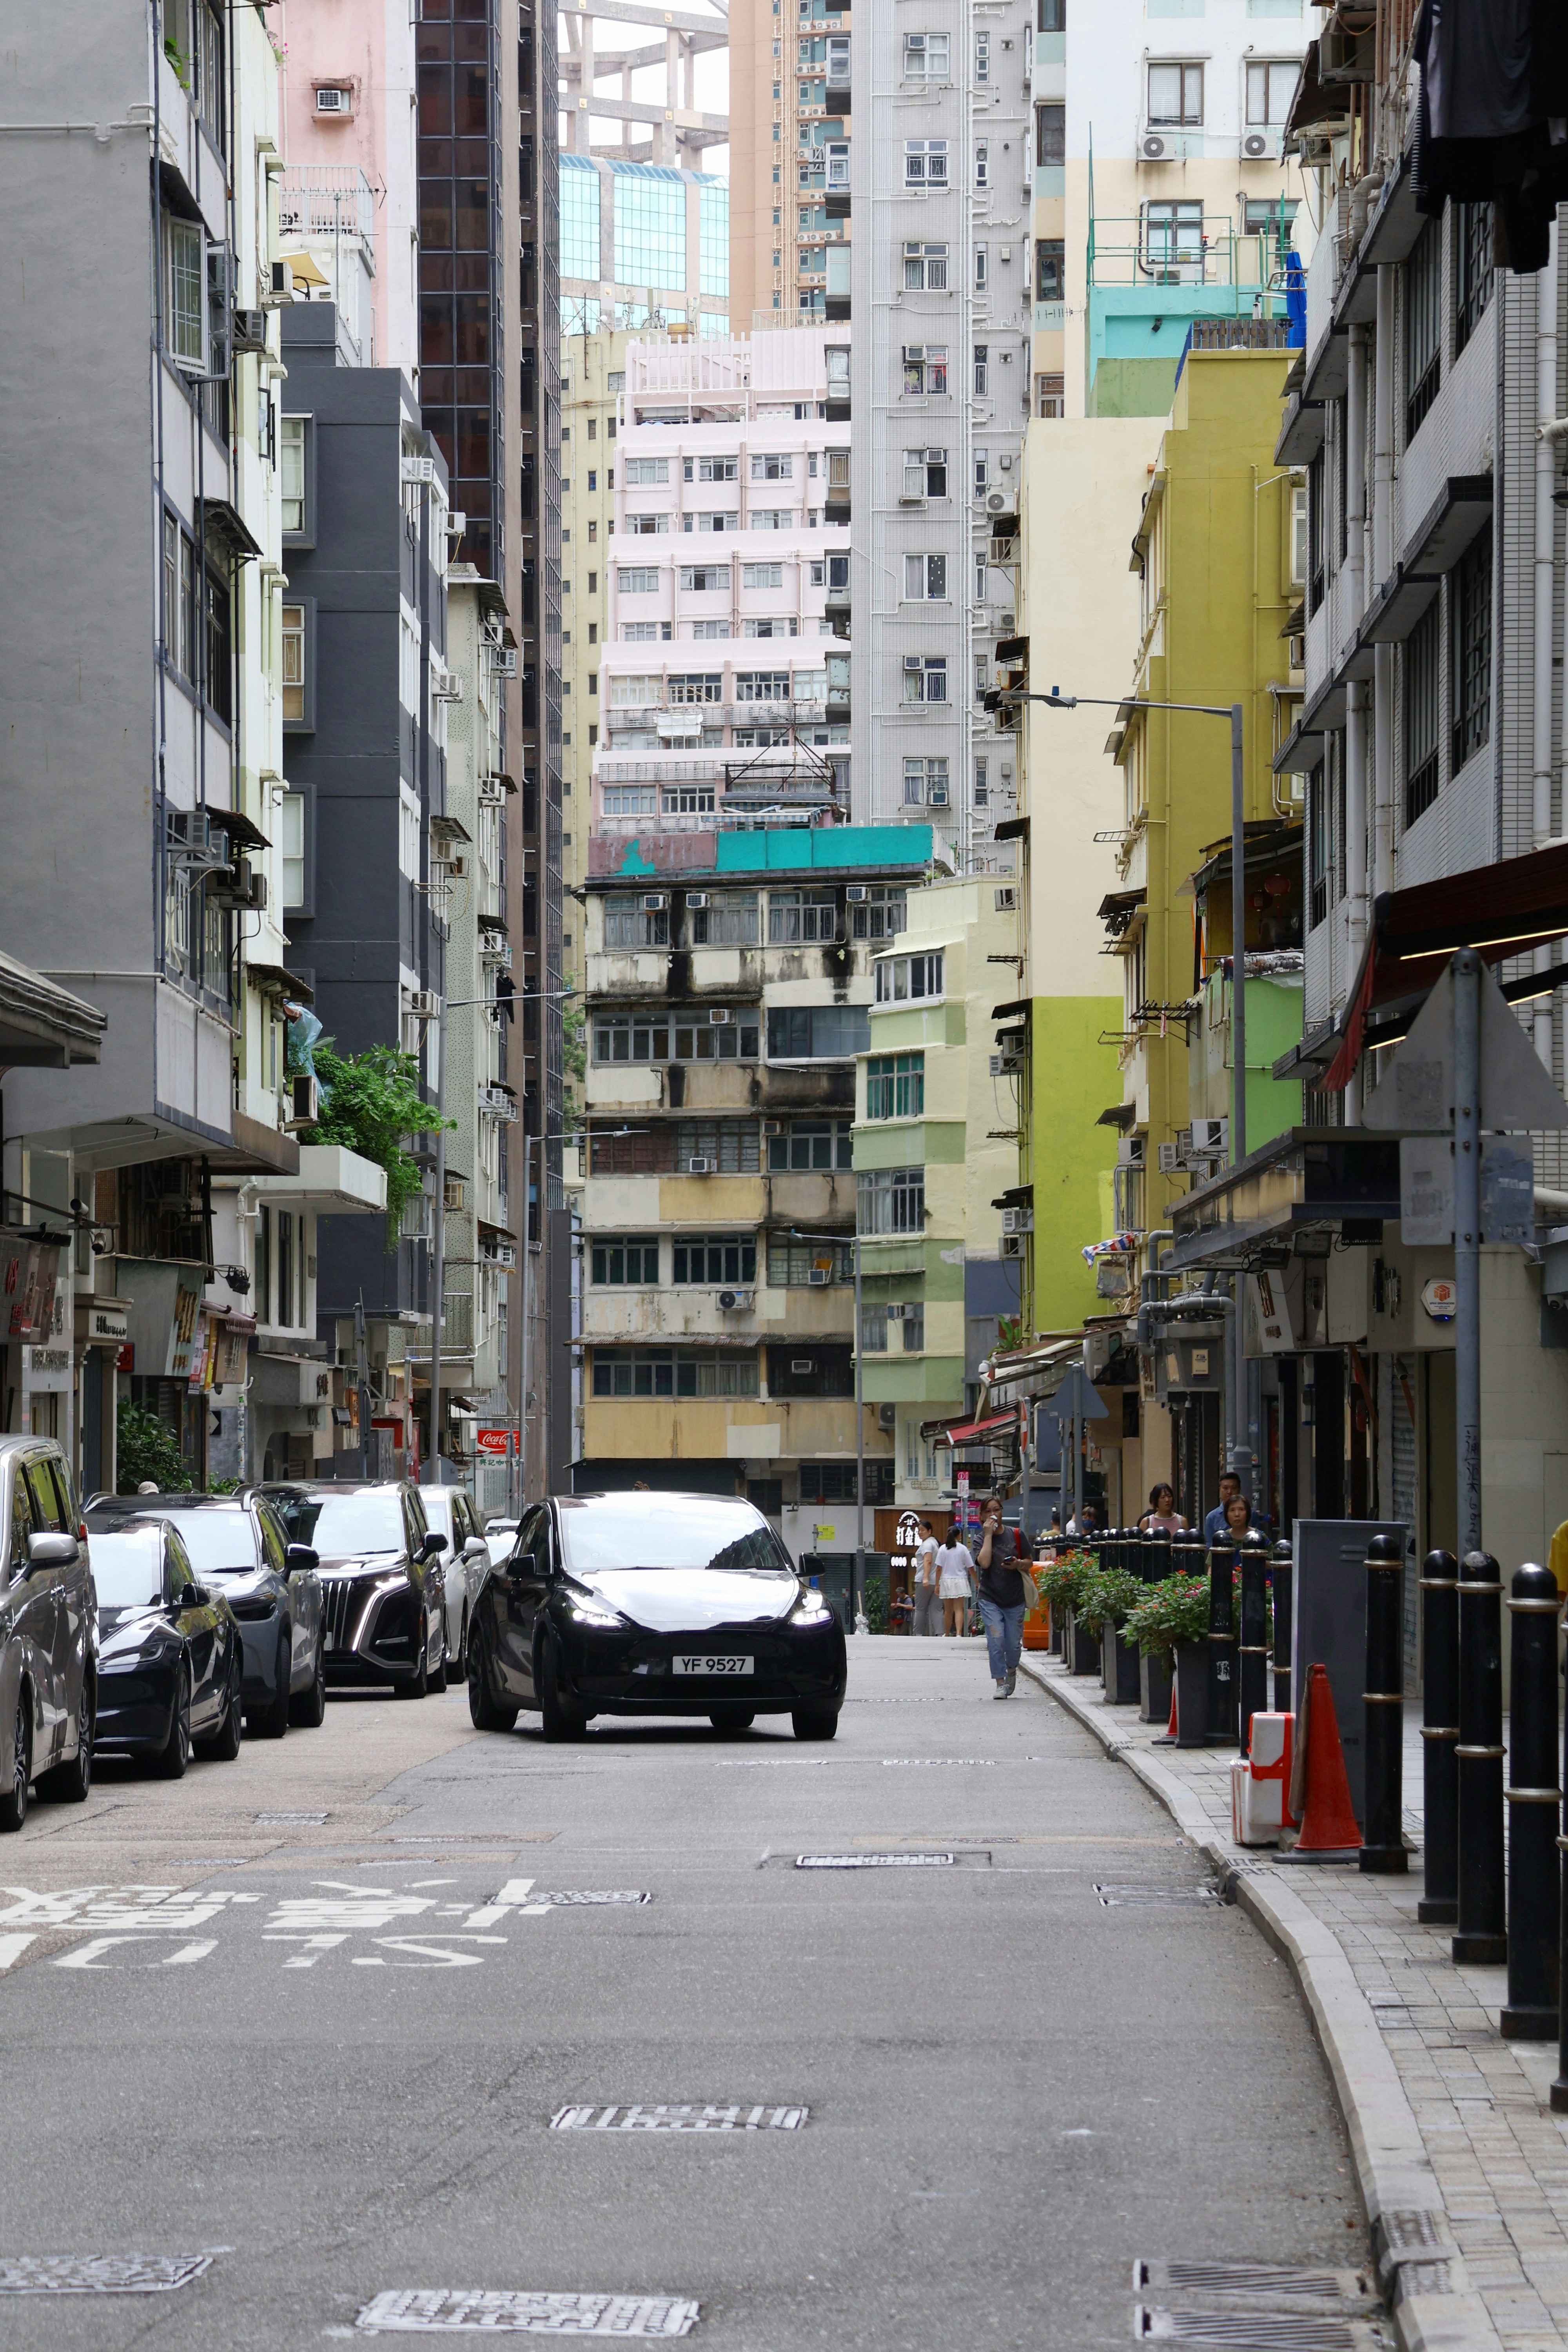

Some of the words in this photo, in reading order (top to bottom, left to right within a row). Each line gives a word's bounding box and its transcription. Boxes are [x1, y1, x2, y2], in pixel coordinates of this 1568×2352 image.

[482, 1433, 519, 1445] Coca-C
[479, 1458, 519, 1466] 興記咖室
[682, 1658, 702, 1672] YF
[706, 1658, 746, 1672] 9527
[0, 1933, 508, 1967] SLO
